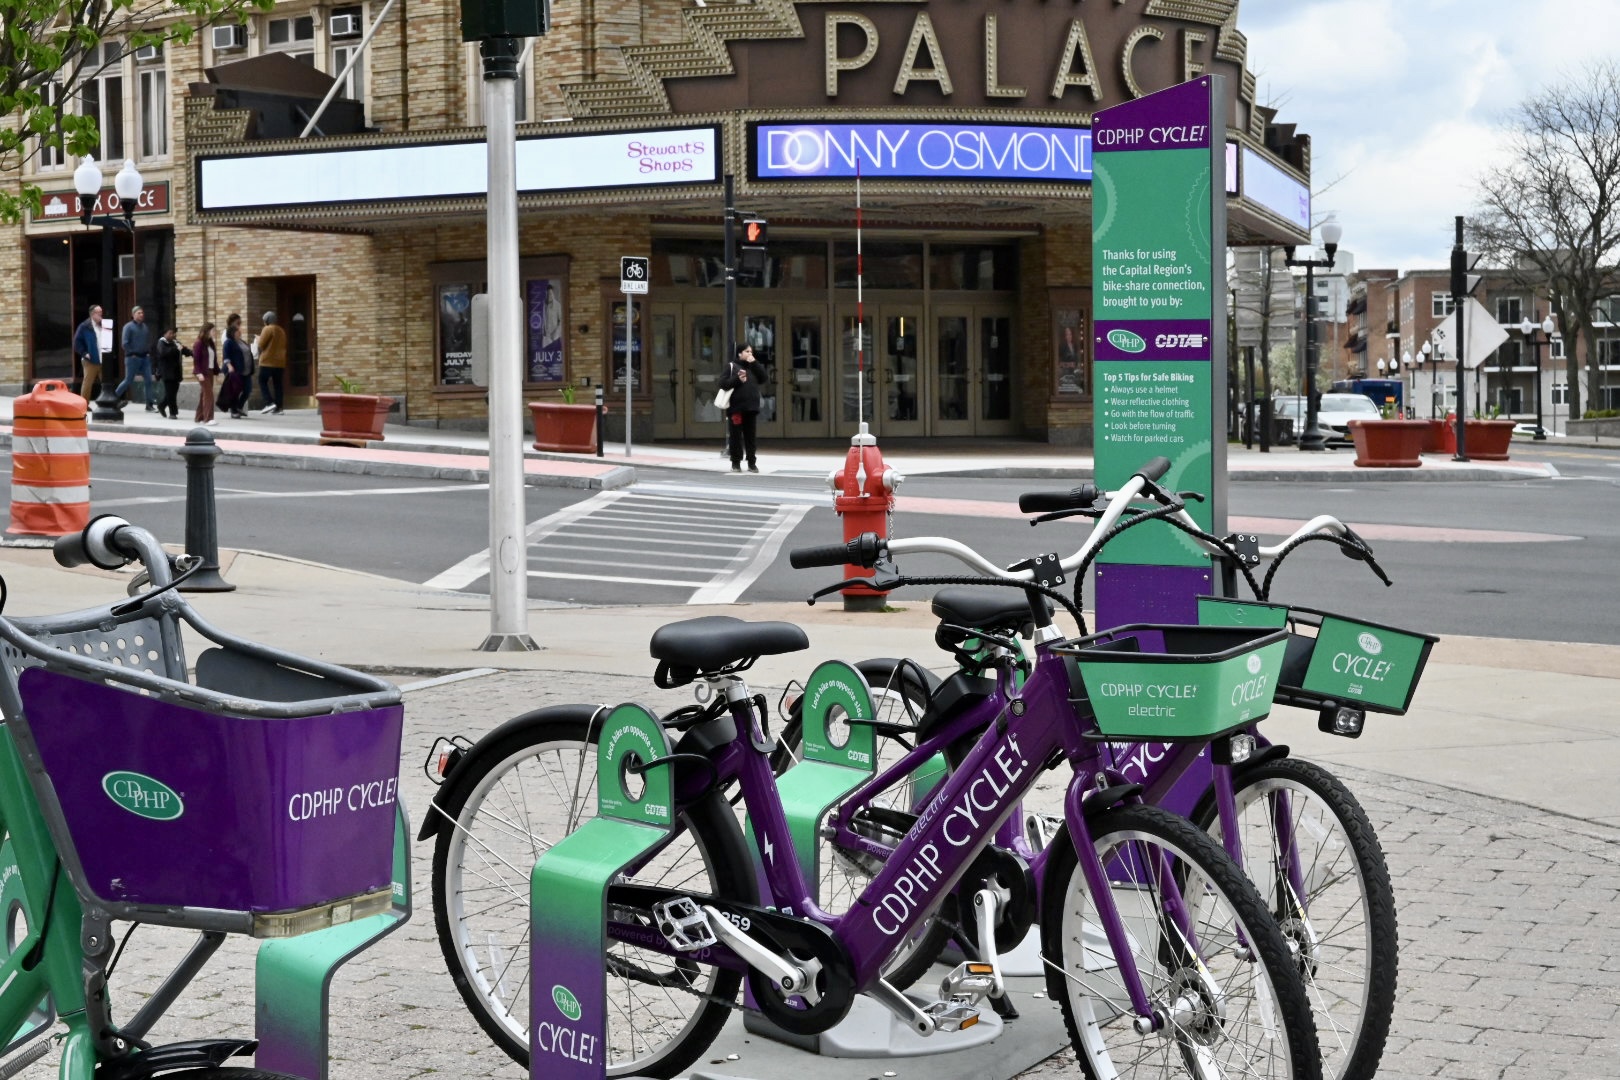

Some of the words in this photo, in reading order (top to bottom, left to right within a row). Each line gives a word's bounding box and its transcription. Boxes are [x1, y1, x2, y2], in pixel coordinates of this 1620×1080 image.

[825, 11, 1207, 100] PALACE
[1097, 128, 1144, 145] CDPHP
[1149, 125, 1205, 143] CYCLE!
[767, 128, 909, 171] DONNY
[75, 196, 102, 213] BX
[1102, 249, 1134, 260] Thanks
[1137, 248, 1150, 259] for
[1152, 249, 1177, 261] using
[1102, 265, 1117, 275] the
[1119, 265, 1152, 277] Capital
[1153, 264, 1192, 277] Region's
[635, 282, 647, 291] LANE
[1103, 281, 1150, 291] bike-share
[1152, 280, 1205, 291] connection,
[1103, 296, 1137, 308] brought
[1139, 297, 1148, 306] to
[1150, 298, 1167, 308] you
[1169, 295, 1183, 308] by:
[1155, 334, 1202, 348] CDTA
[533, 352, 554, 362] JULY
[556, 351, 562, 361] 3
[1103, 373, 1117, 383] Top
[1118, 373, 1123, 382] 5
[1124, 373, 1140, 383] Tips
[1140, 372, 1152, 382] for
[1152, 372, 1170, 382] Safe
[1170, 372, 1194, 383] Biking
[1110, 386, 1134, 395] Always
[1155, 385, 1178, 394] helmet
[1110, 398, 1128, 406] Wear
[1129, 398, 1160, 406] reflective
[1162, 397, 1189, 407] clothing
[1111, 410, 1120, 418] Go
[1122, 410, 1136, 418] with
[1138, 410, 1148, 418] the
[1150, 410, 1165, 418] flow
[1166, 410, 1173, 418] of
[1174, 410, 1195, 418] traffic
[1111, 422, 1127, 430] Look
[1129, 422, 1151, 430] before
[1152, 422, 1176, 432] turning
[1110, 434, 1132, 442] Watch
[1133, 434, 1143, 442] for
[1144, 434, 1168, 443] parked
[1332, 652, 1392, 681] CYCLE!
[1101, 683, 1142, 697] CDPHP
[1146, 684, 1197, 698] CYCLE!
[1231, 675, 1267, 707] CYCLE!
[811, 693, 821, 709] Lock
[818, 681, 829, 695] bike
[836, 680, 855, 701] opposite
[854, 700, 862, 718] side
[1128, 704, 1176, 717] electric
[606, 742, 615, 760] Lock
[612, 727, 623, 743] bike
[622, 725, 630, 734] on
[630, 725, 651, 748] opposite
[114, 780, 170, 808] CDPHP
[289, 787, 343, 821] CDPHP
[347, 777, 398, 811] CYCLE!
[910, 787, 949, 841] electric
[873, 842, 943, 935] CDPHP
[942, 734, 1029, 847] CYCLE!
[608, 925, 654, 945] powered
[655, 933, 668, 949] by
[539, 1022, 594, 1065] CYCLE!
